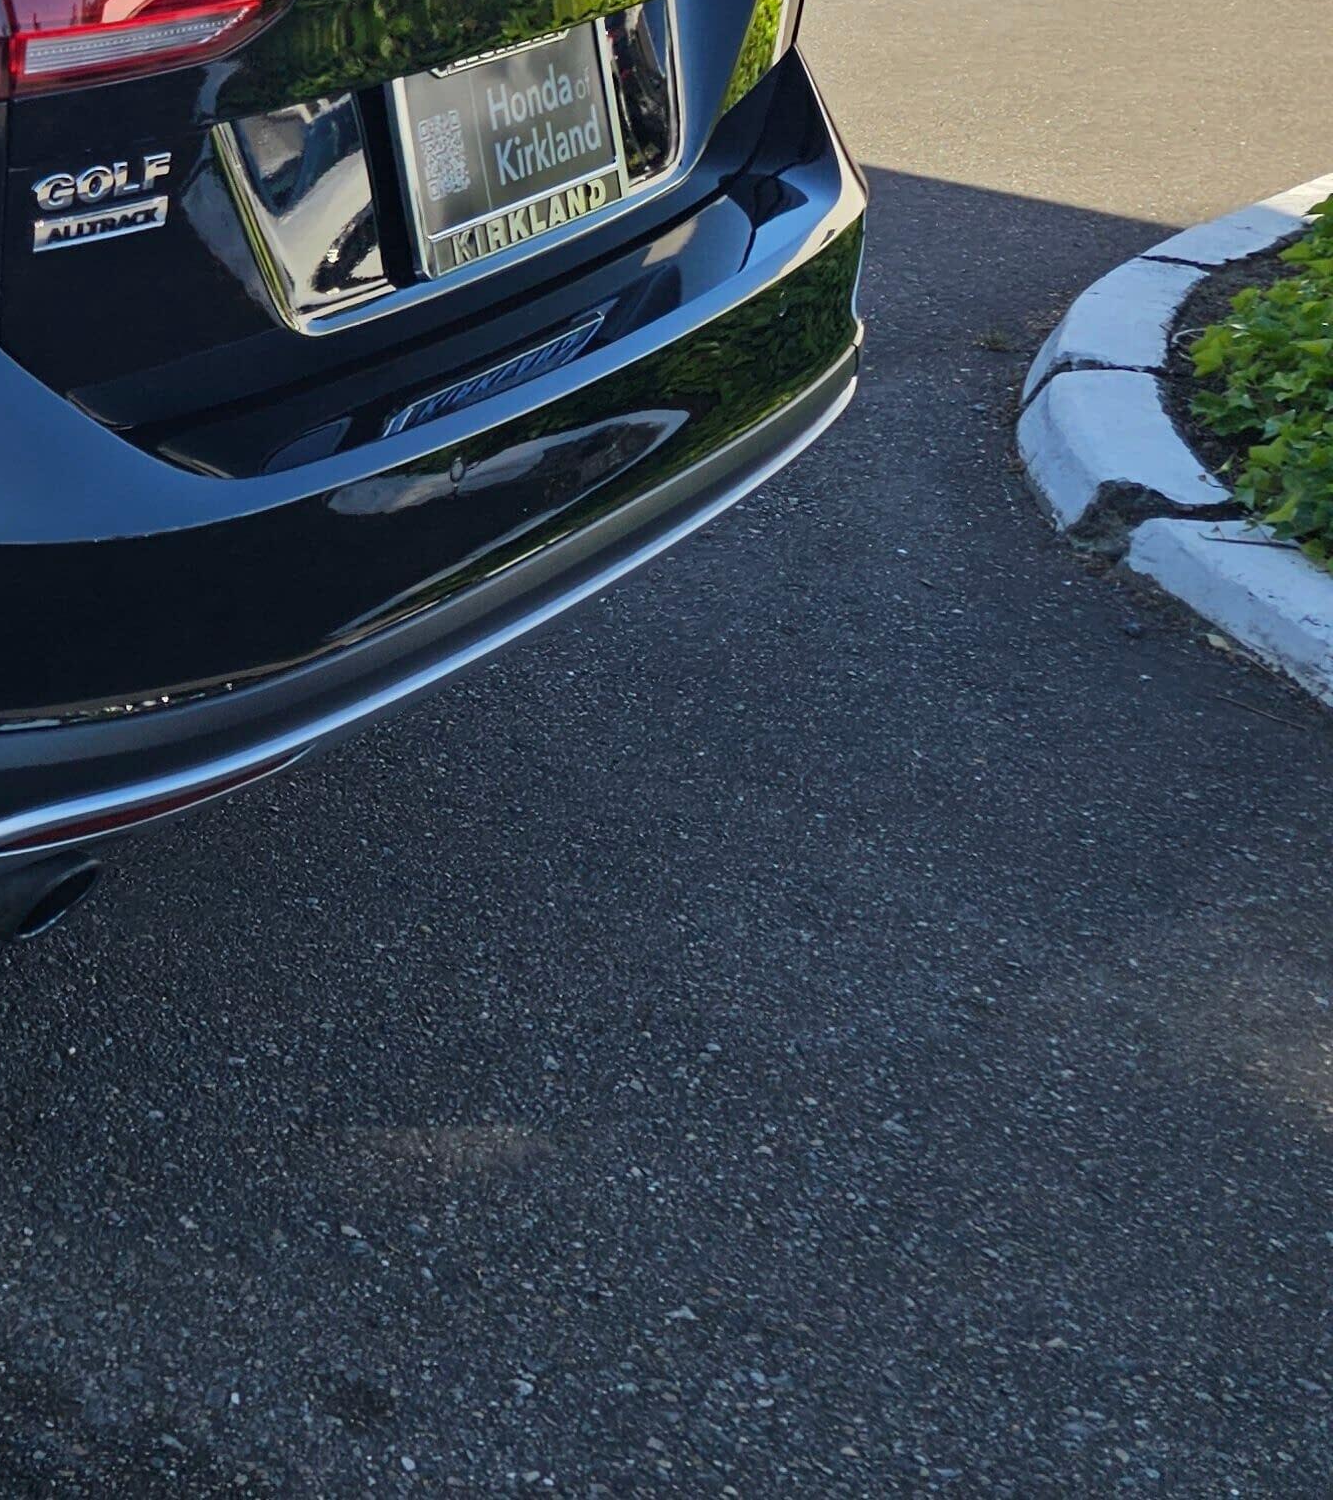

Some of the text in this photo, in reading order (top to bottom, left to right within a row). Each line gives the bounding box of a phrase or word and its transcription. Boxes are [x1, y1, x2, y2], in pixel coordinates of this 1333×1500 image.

[486, 63, 592, 132] Honda of
[494, 103, 603, 187] Kirkland
[31, 151, 173, 211] GOLF
[47, 206, 159, 245] ALLTRACK
[451, 178, 608, 266] KIRKLAND
